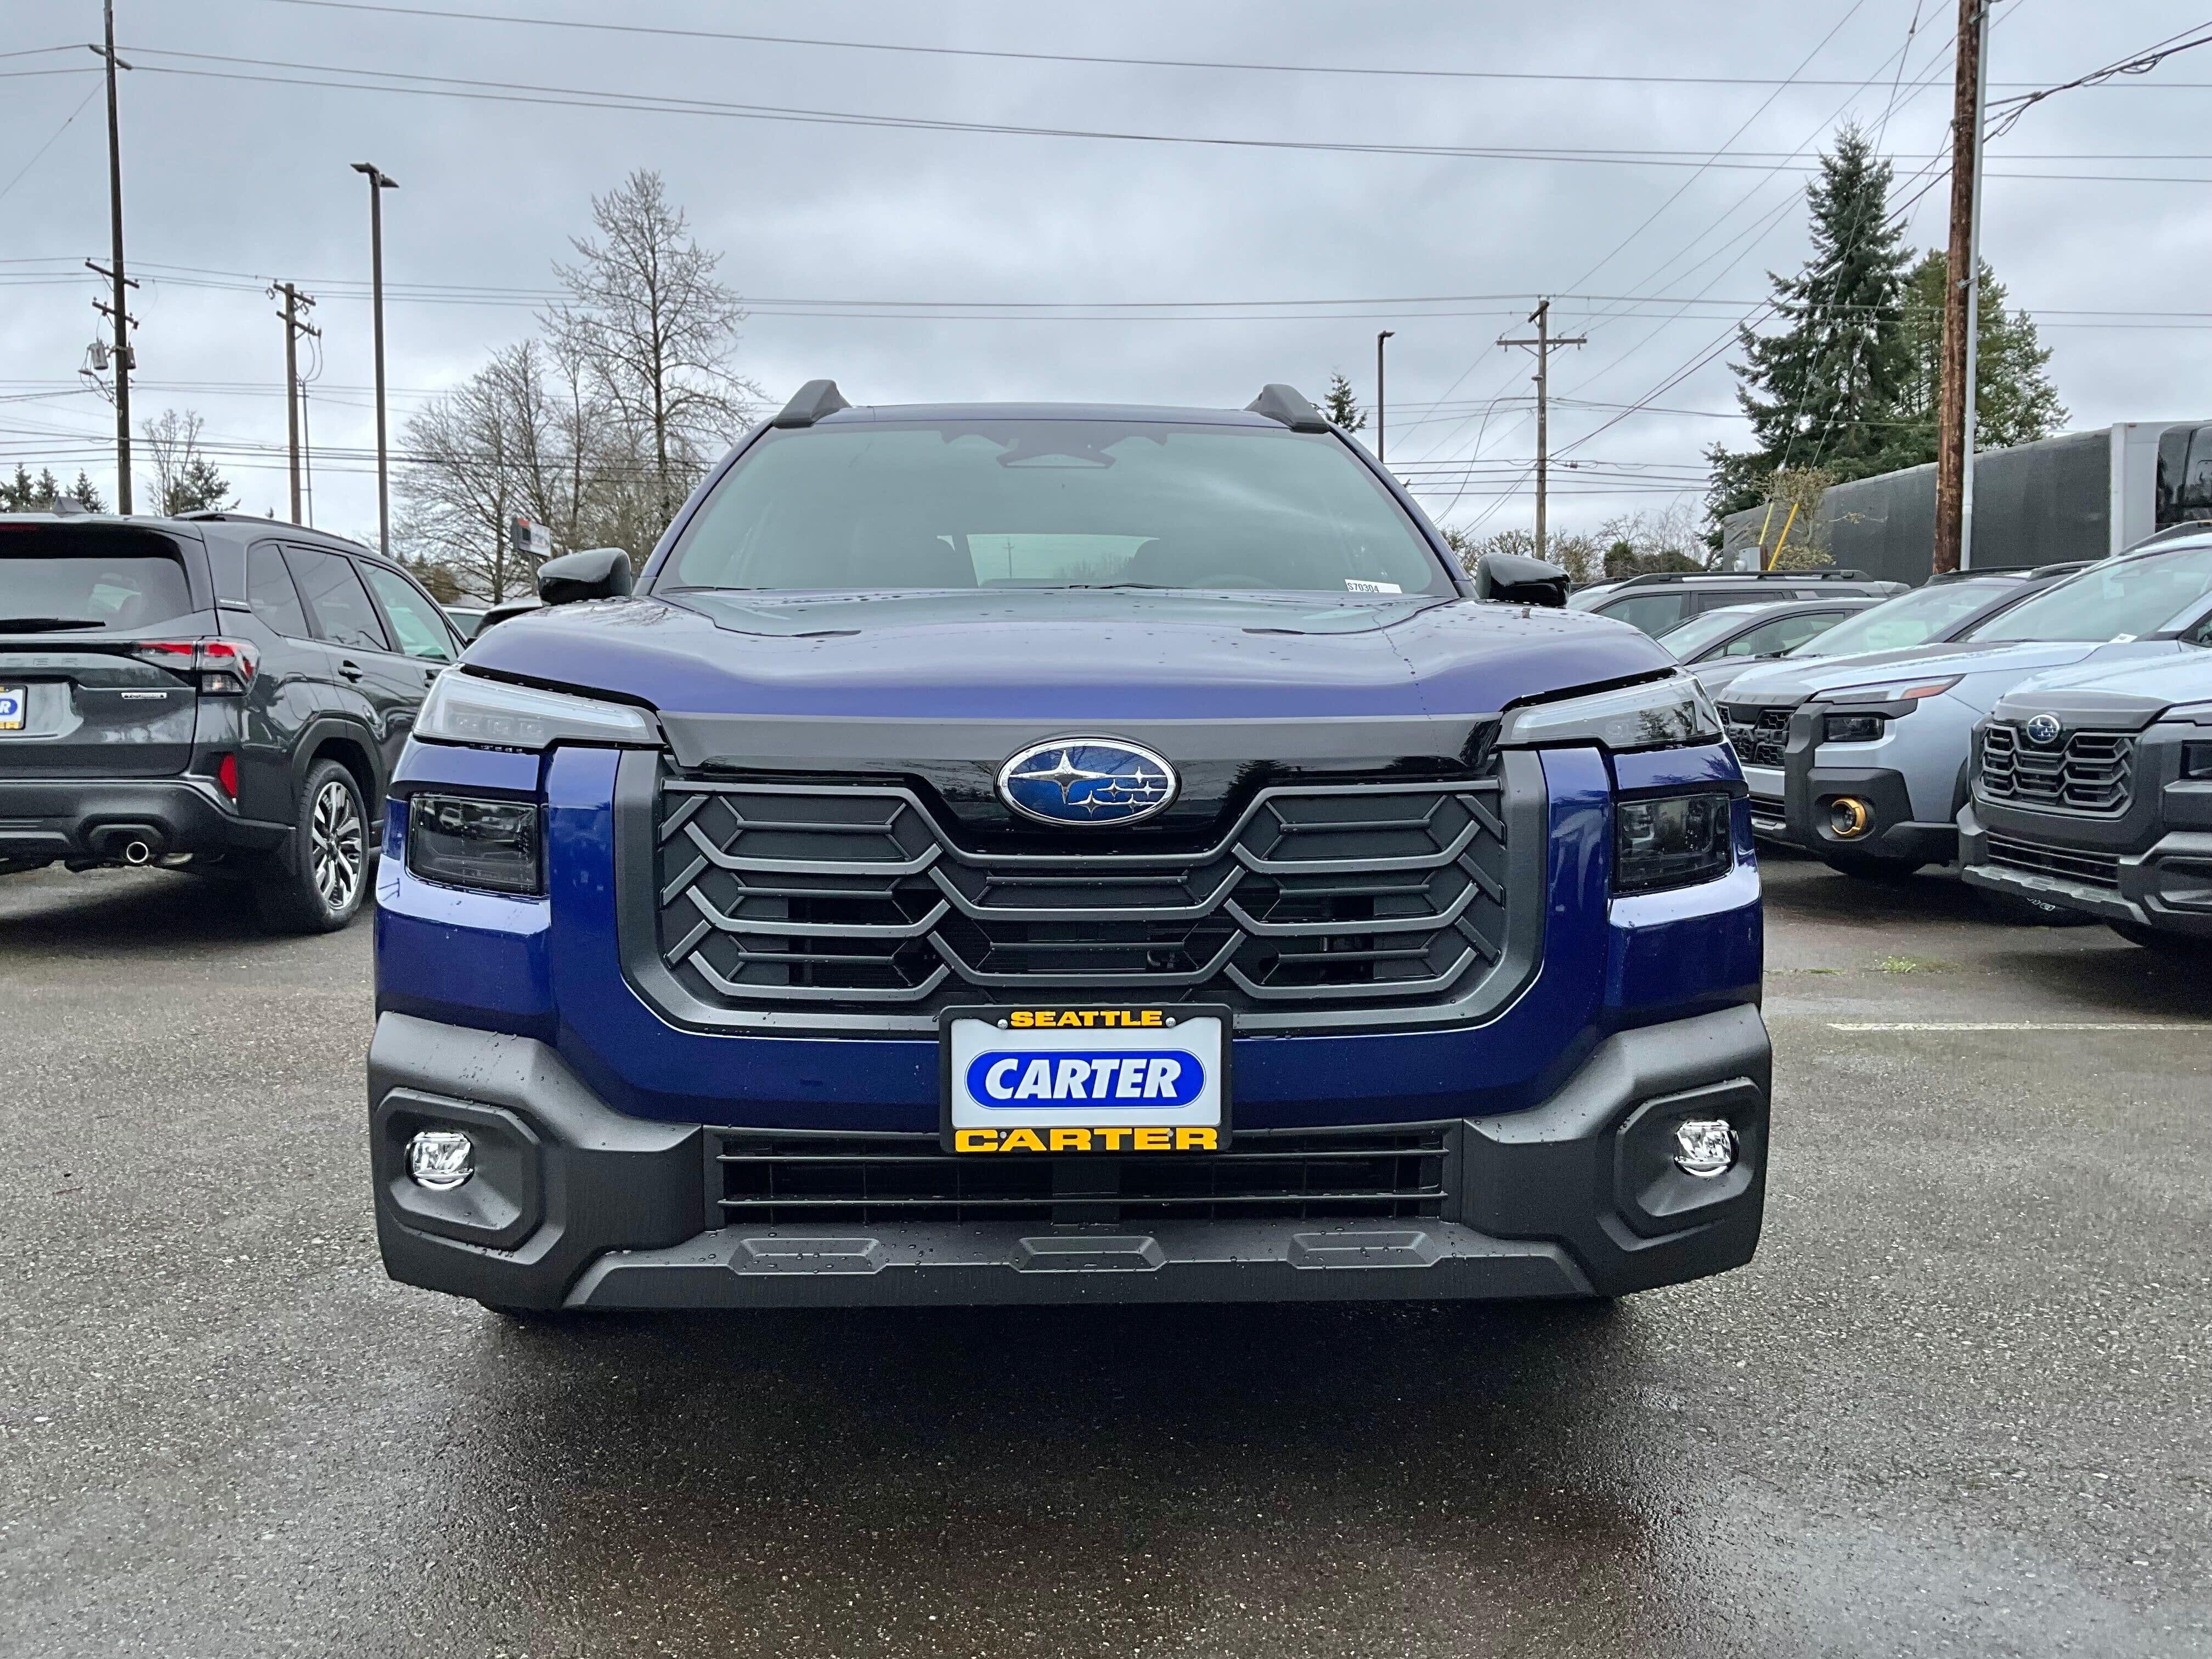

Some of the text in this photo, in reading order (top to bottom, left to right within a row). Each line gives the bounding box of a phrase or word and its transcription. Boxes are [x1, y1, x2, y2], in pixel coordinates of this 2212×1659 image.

[1347, 583, 1379, 593] S70304
[1010, 1011, 1163, 1027] SEATTLE
[985, 1058, 1181, 1099] CARTER
[955, 1128, 1217, 1152] CARTER
